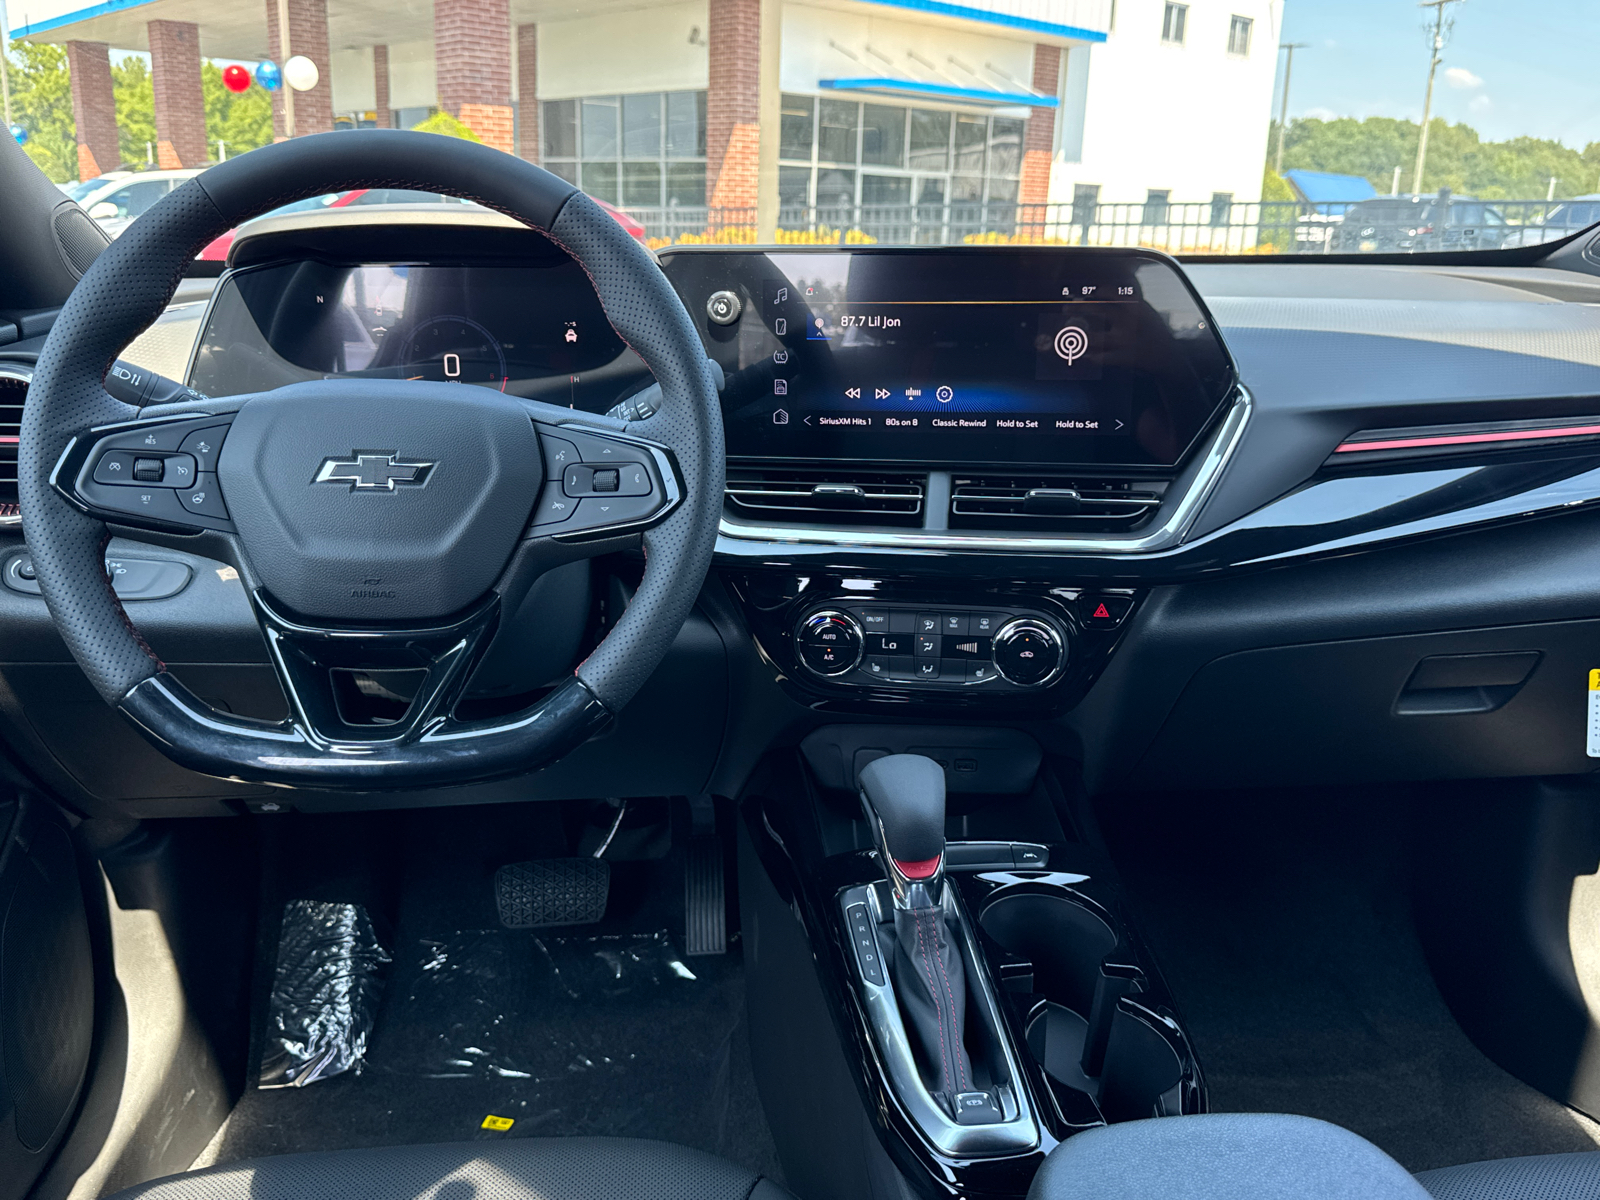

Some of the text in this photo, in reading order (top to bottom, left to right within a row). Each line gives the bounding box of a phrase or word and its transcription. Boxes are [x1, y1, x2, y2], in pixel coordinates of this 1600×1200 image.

[1117, 286, 1134, 295] 1:15
[316, 295, 324, 304] N
[840, 315, 901, 329] 87.7 Lil Jon
[443, 353, 460, 377] 0
[819, 417, 872, 426] SiriusXM Hits 1
[885, 418, 900, 427] 80s
[912, 418, 919, 427] 8
[932, 418, 987, 428] Classic Rewind
[996, 419, 1039, 428] Hold to Set
[1055, 420, 1099, 429] Hold to Set
[350, 590, 396, 599] AIRBAG
[822, 633, 837, 641] AUTO
[882, 637, 897, 650] Lo
[859, 925, 866, 933] R
[862, 939, 870, 947] N
[866, 954, 873, 962] D
[870, 968, 876, 976] L
